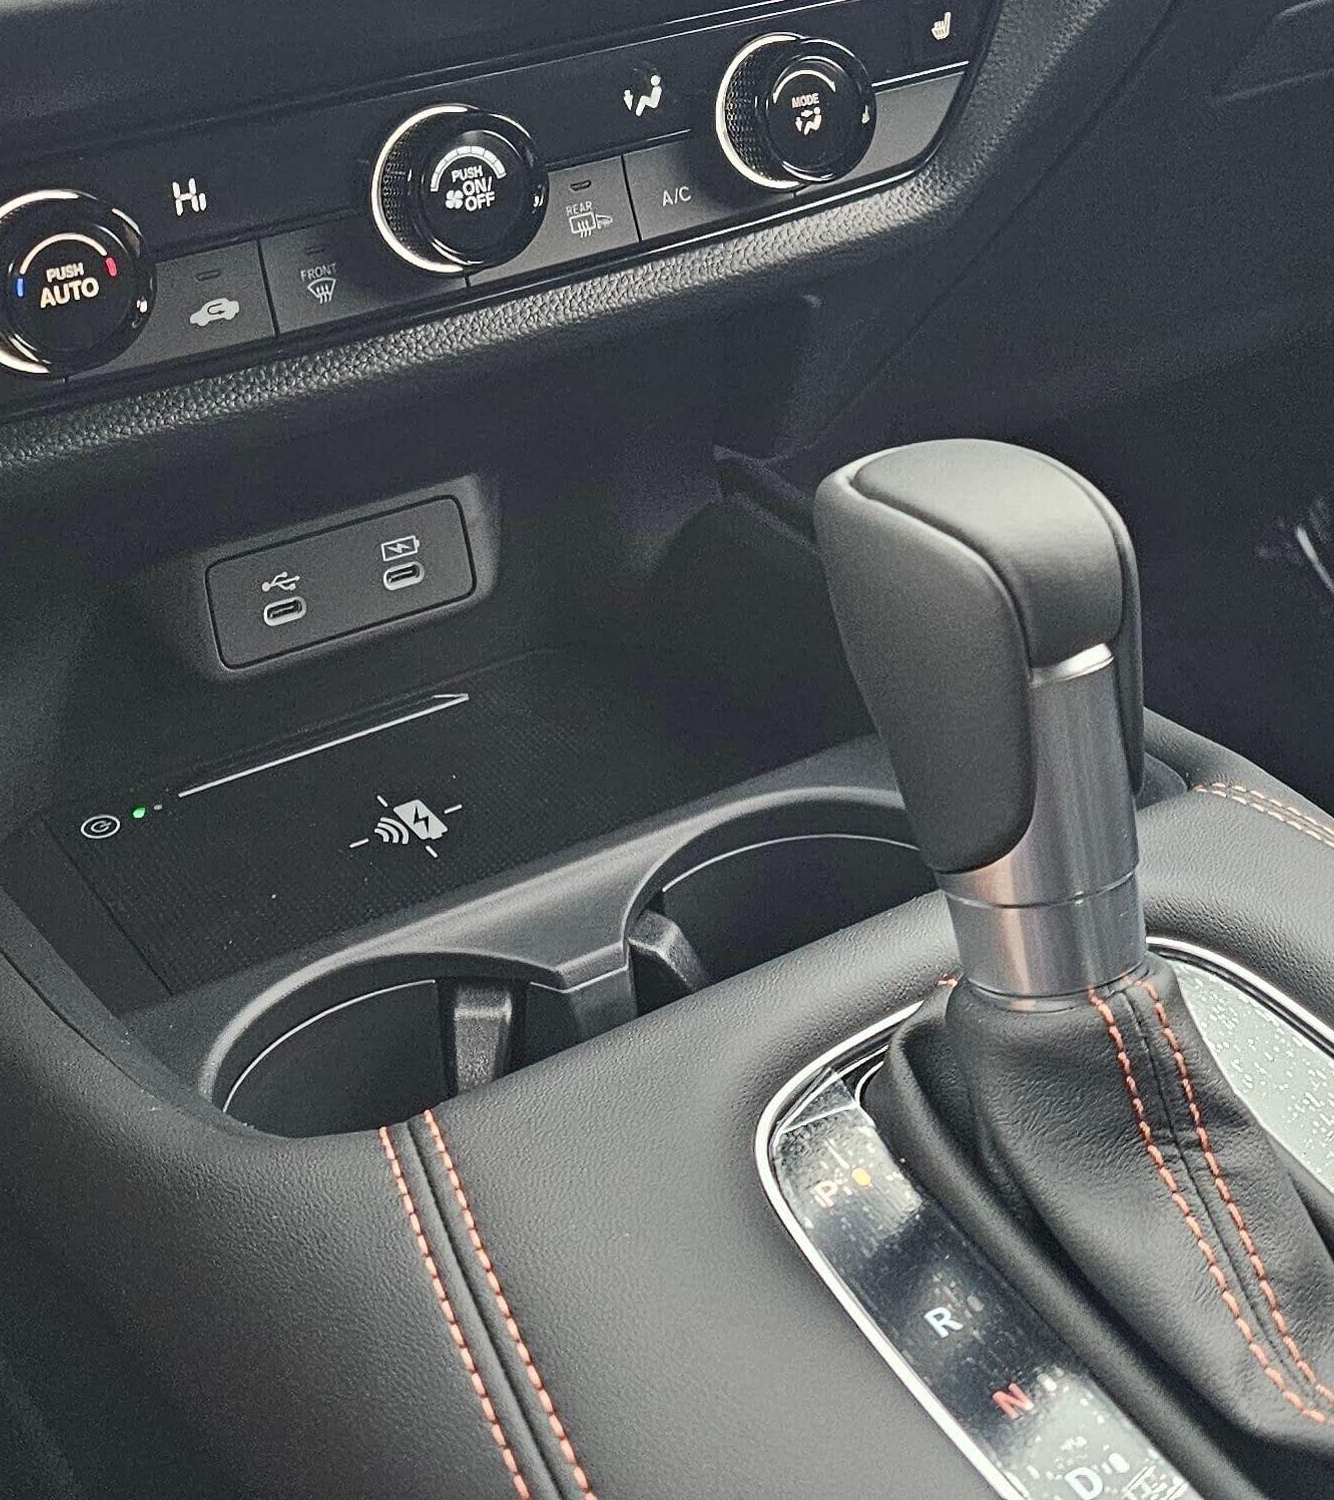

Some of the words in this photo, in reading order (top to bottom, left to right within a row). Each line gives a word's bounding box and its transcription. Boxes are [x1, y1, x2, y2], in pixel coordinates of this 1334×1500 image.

[791, 92, 819, 108] MODE
[451, 165, 483, 182] PUSH
[462, 176, 492, 196] ON/
[661, 186, 692, 206] A/C
[465, 191, 495, 211] OFF
[566, 201, 592, 215] REAR
[46, 262, 84, 283] PUSH
[300, 262, 338, 283] FRONT
[40, 277, 99, 309] AUTO
[810, 1181, 838, 1208] P
[924, 1306, 962, 1338] R
[992, 1383, 1034, 1420] N
[1065, 1467, 1103, 1500] D
